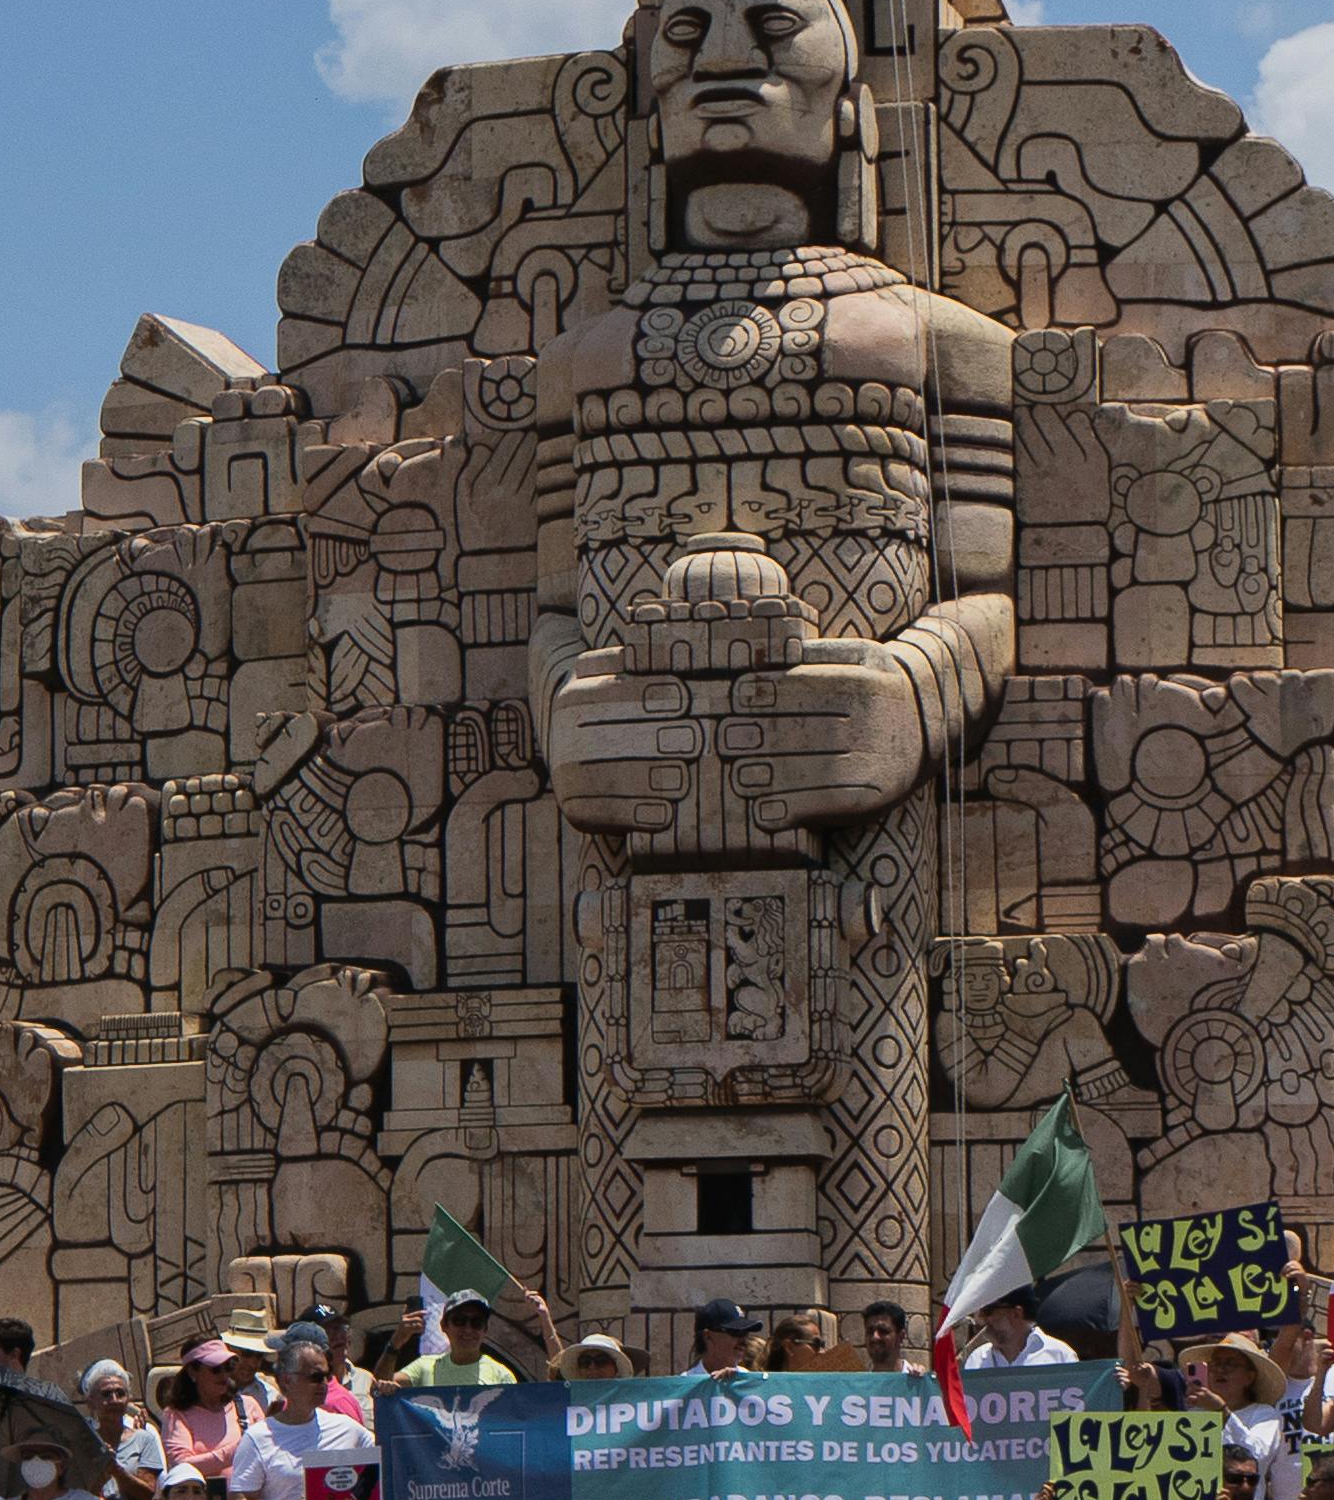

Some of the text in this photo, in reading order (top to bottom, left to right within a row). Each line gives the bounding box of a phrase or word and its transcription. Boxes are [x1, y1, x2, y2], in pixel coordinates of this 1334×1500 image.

[1120, 1223, 1162, 1275] La
[1169, 1213, 1223, 1272] Ley
[1135, 1262, 1288, 1330] es La Ley
[567, 1394, 793, 1436] DIPUTADOS
[804, 1395, 831, 1426] Y
[574, 1436, 1051, 1470] REPRESENTANTES DE LOS YUCATEC
[1052, 1415, 1102, 1476] La
[1108, 1415, 1164, 1473] Ley
[471, 1476, 511, 1497] Corte
